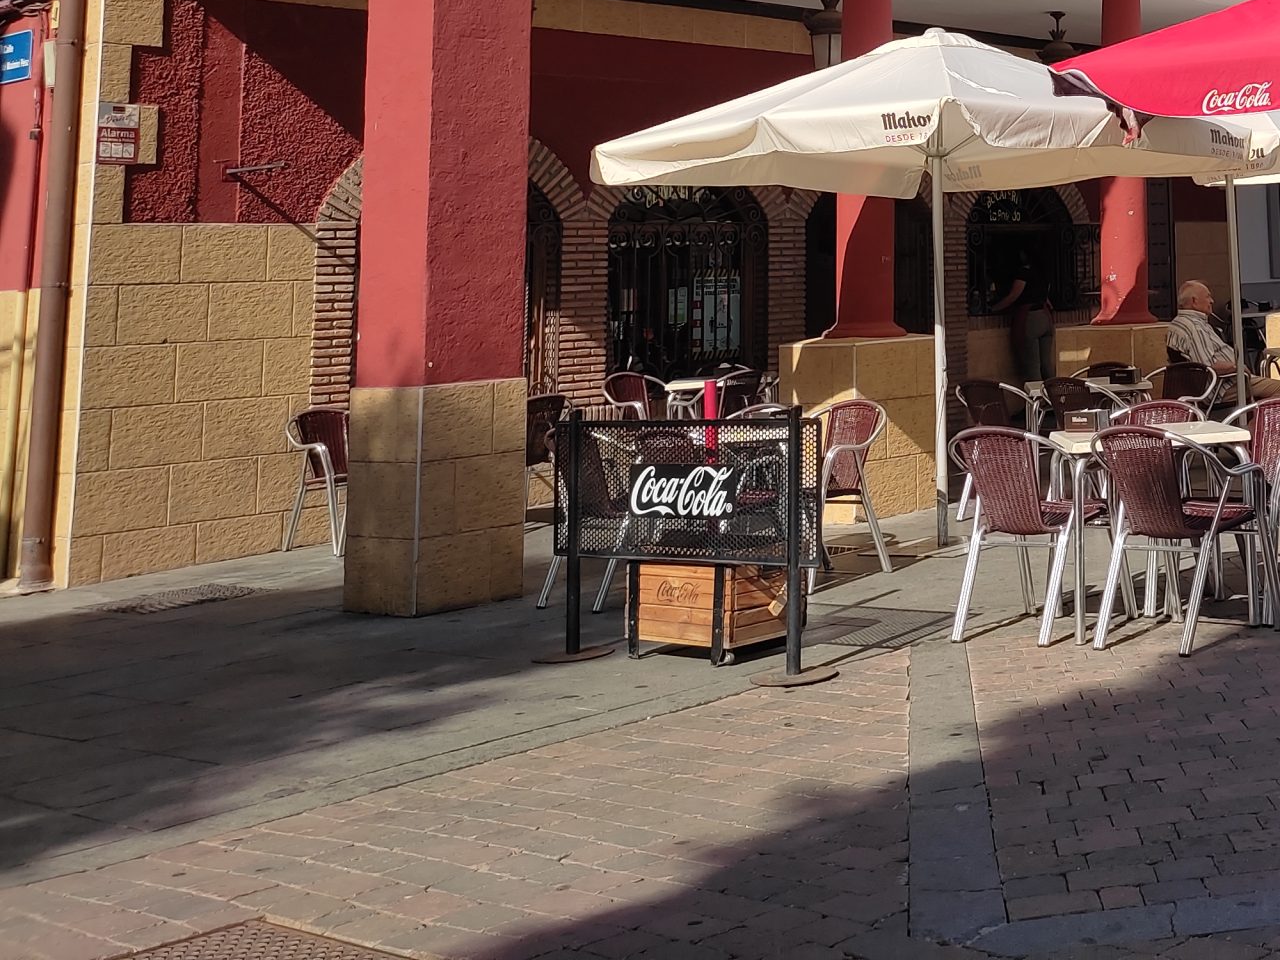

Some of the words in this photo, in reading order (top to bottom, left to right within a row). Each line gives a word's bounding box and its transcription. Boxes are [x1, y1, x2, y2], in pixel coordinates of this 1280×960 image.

[1202, 81, 1273, 114] Coca-Cola
[101, 128, 135, 138] Alarma
[885, 133, 915, 143] DESDE
[631, 466, 734, 517] Coca-Cola
[656, 580, 700, 603] Coca-Cola
